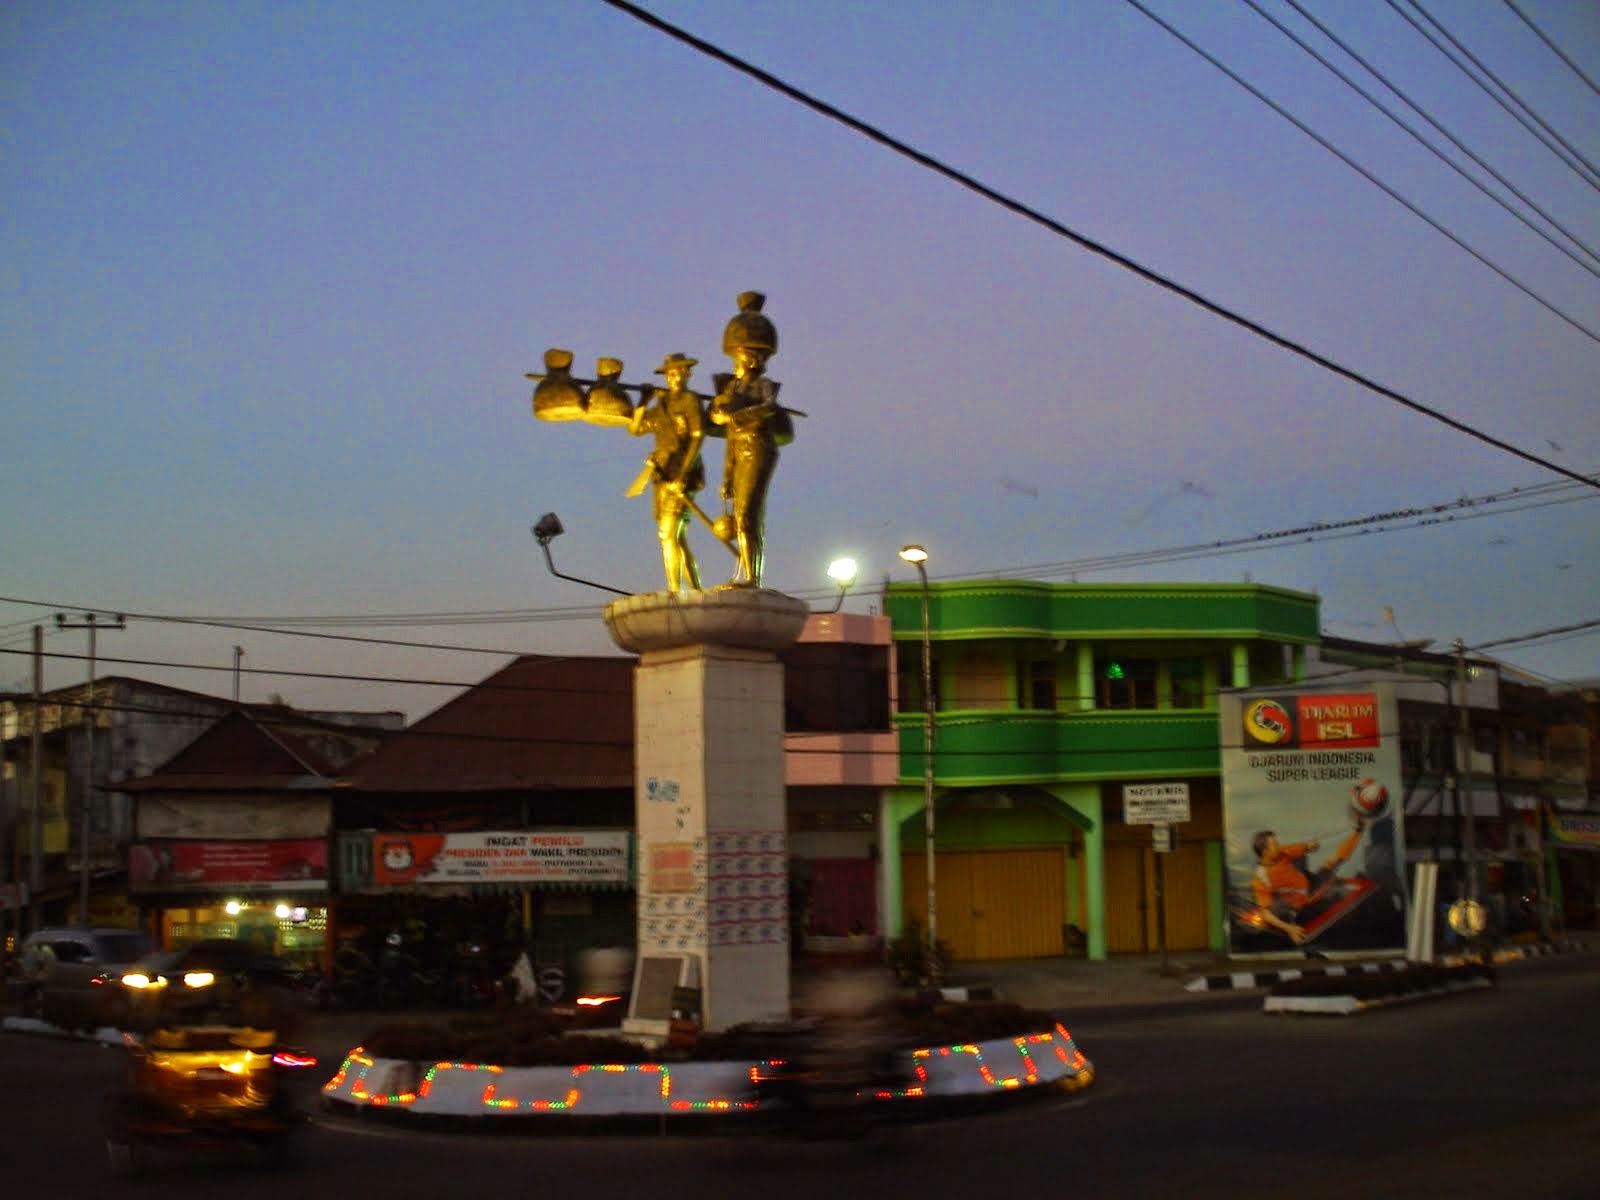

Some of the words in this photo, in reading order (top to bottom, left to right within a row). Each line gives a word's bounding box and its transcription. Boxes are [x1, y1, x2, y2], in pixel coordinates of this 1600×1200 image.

[1303, 703, 1374, 720] DJARUM
[1318, 722, 1360, 739] ISL
[1250, 752, 1304, 769] DJARUM
[1308, 751, 1376, 766] INDONESIA
[1266, 769, 1309, 782] SUPER
[1312, 767, 1361, 781] LEAGUE
